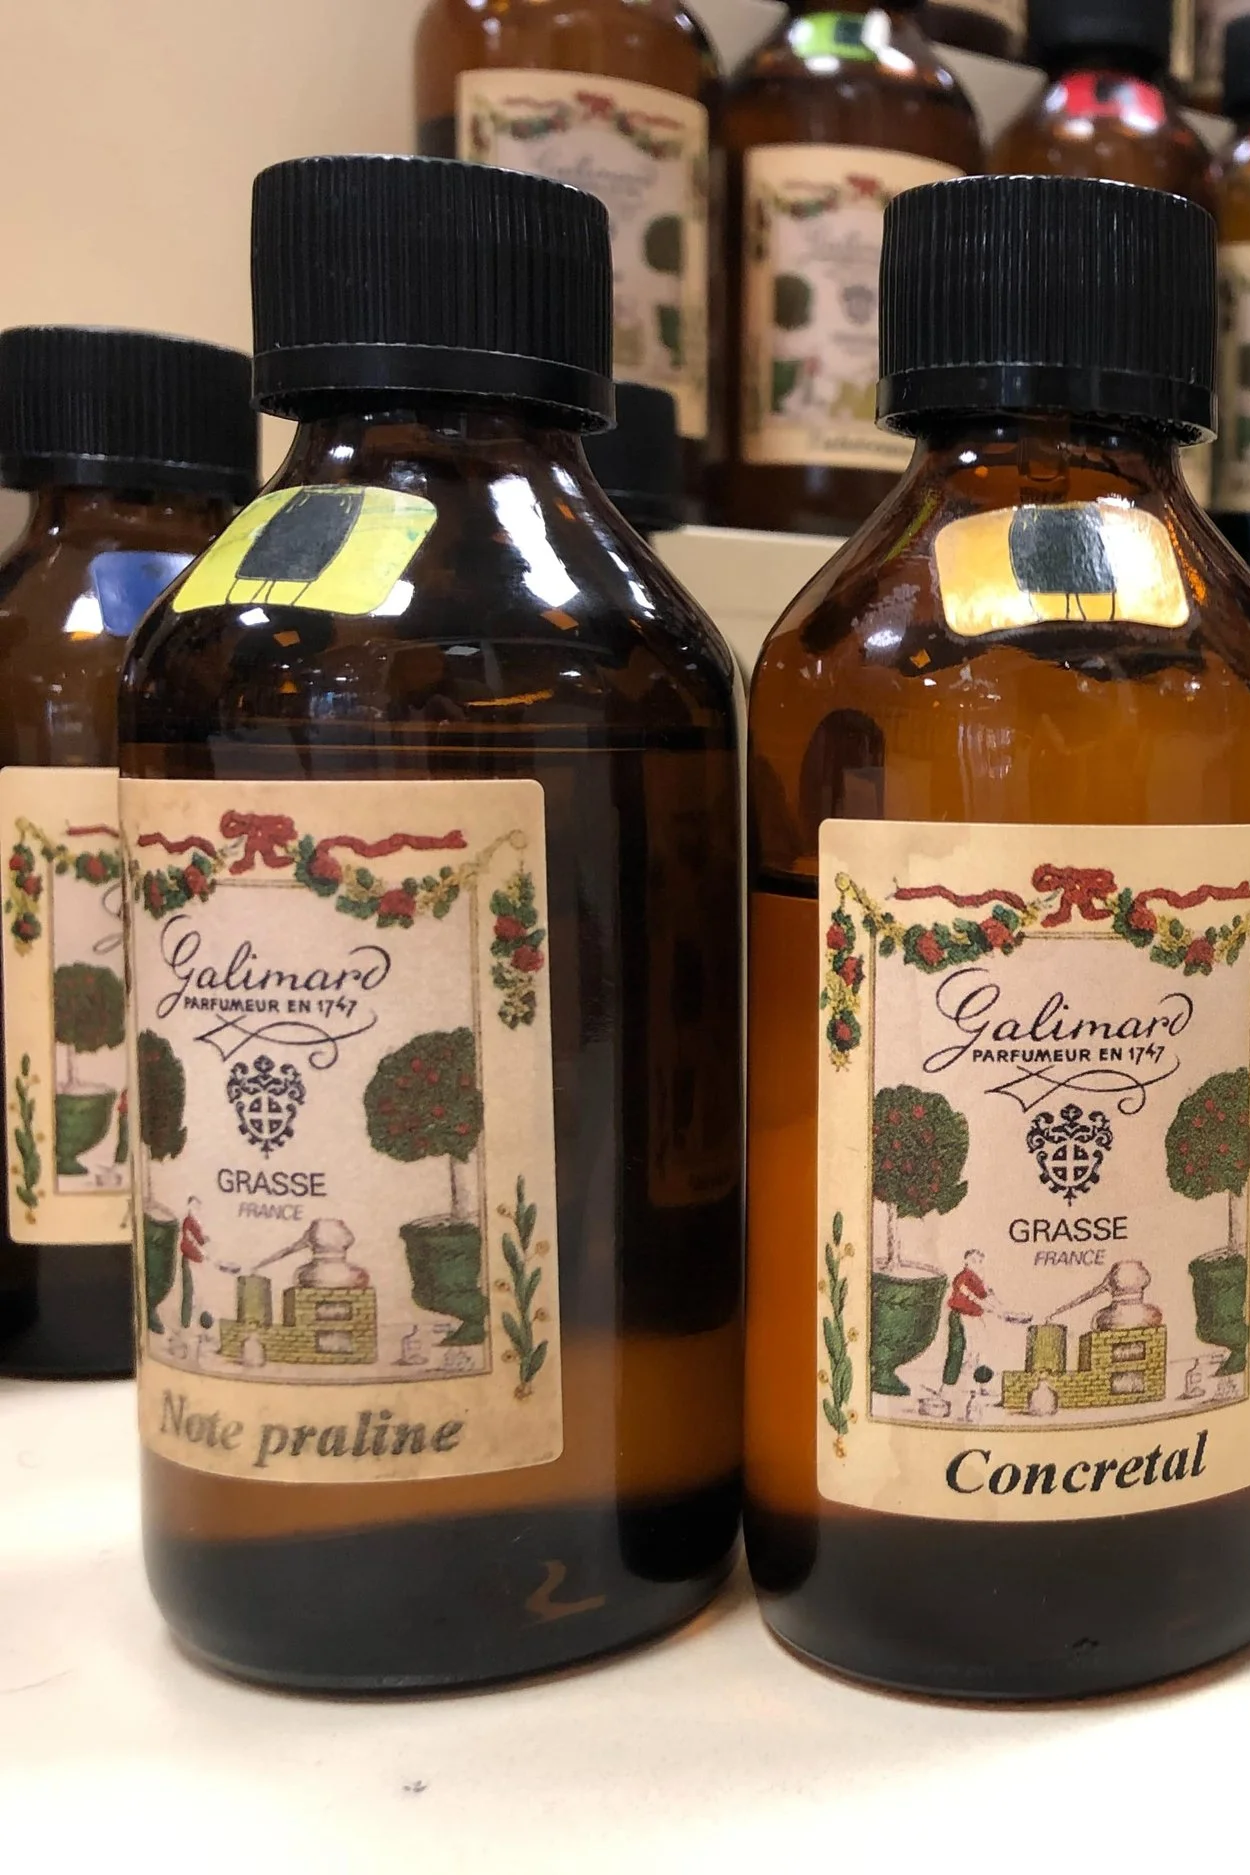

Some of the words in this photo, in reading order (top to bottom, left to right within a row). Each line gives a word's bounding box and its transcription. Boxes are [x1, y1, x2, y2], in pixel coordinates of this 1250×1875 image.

[157, 914, 391, 1018] Galimard
[184, 996, 279, 1013] PARFUMEUR
[288, 999, 311, 1013] EN
[318, 996, 358, 1018] 1747
[923, 967, 1193, 1073] Galimard
[972, 1047, 1091, 1062] PARFUMEUR
[1099, 1047, 1122, 1061] EN
[1129, 1042, 1165, 1065] 1747
[217, 1168, 327, 1197] GRASSE
[238, 1203, 304, 1221] FRANCE
[1009, 1216, 1128, 1243] GRASSE
[1034, 1249, 1107, 1266] FRANCE
[160, 1387, 244, 1451] Note
[252, 1408, 466, 1468] praline
[945, 1429, 1208, 1495] Concretal
